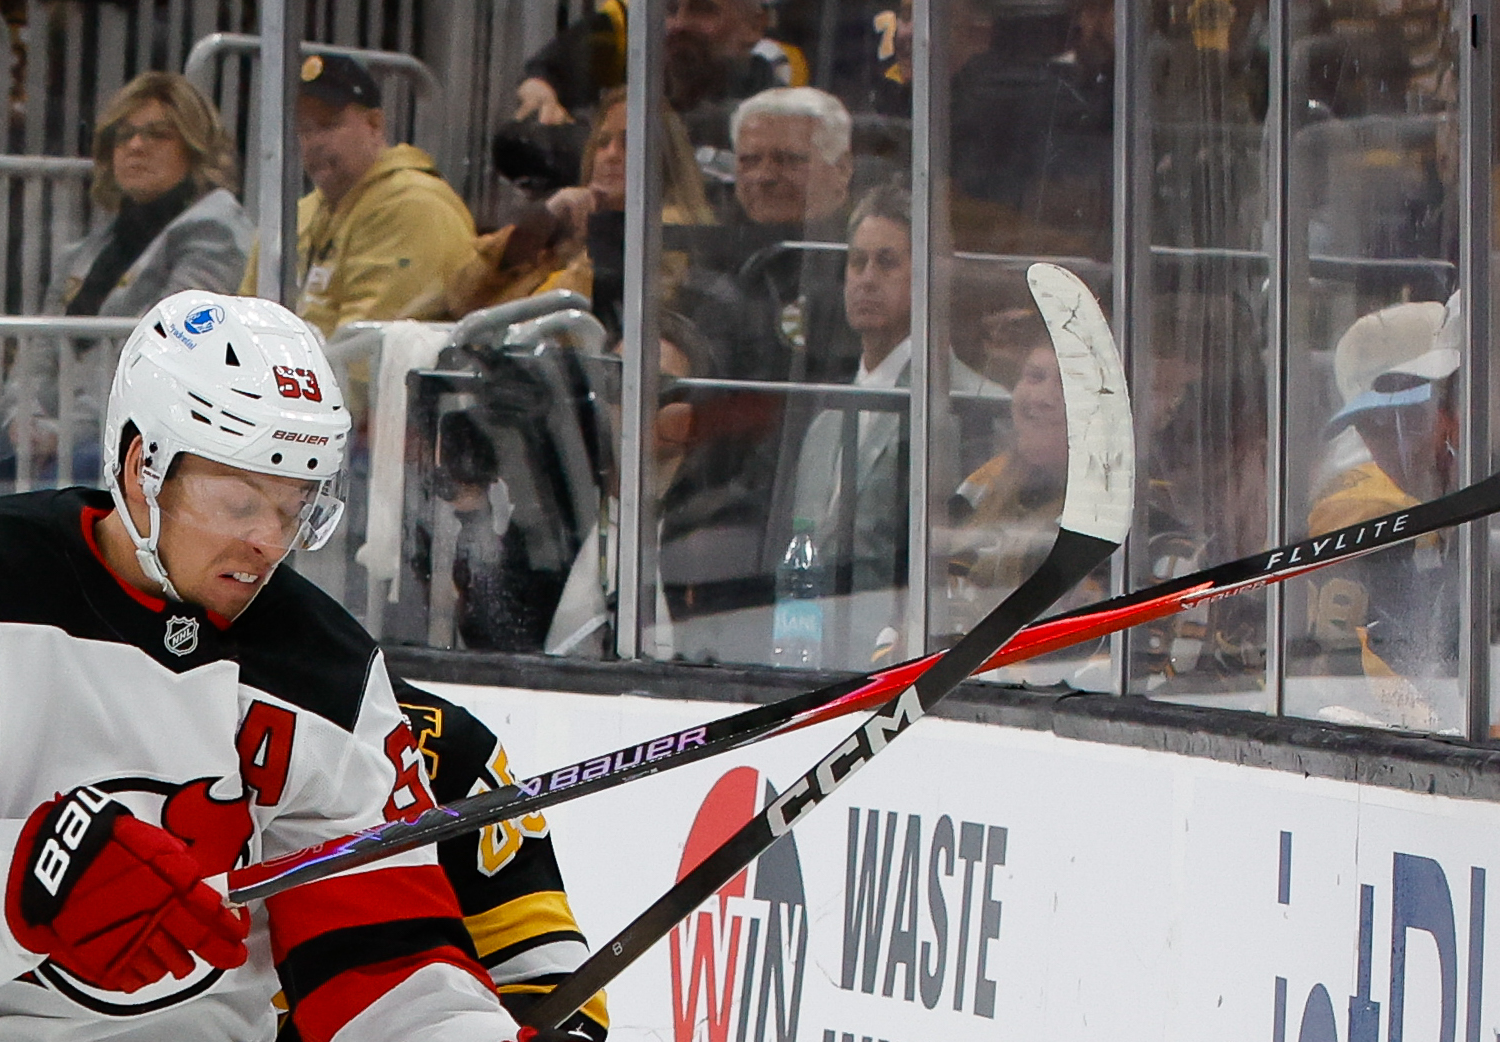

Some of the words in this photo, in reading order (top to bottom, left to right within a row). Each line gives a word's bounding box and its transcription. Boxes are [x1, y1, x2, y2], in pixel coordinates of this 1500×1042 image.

[272, 364, 323, 404] 63
[271, 429, 330, 447] BAUER
[1264, 512, 1411, 571] FLYLITE
[171, 625, 194, 647] NHL
[236, 699, 297, 807] A
[548, 726, 708, 792] BAUER
[766, 684, 926, 838] CCM
[840, 805, 1009, 1020] WASTE
